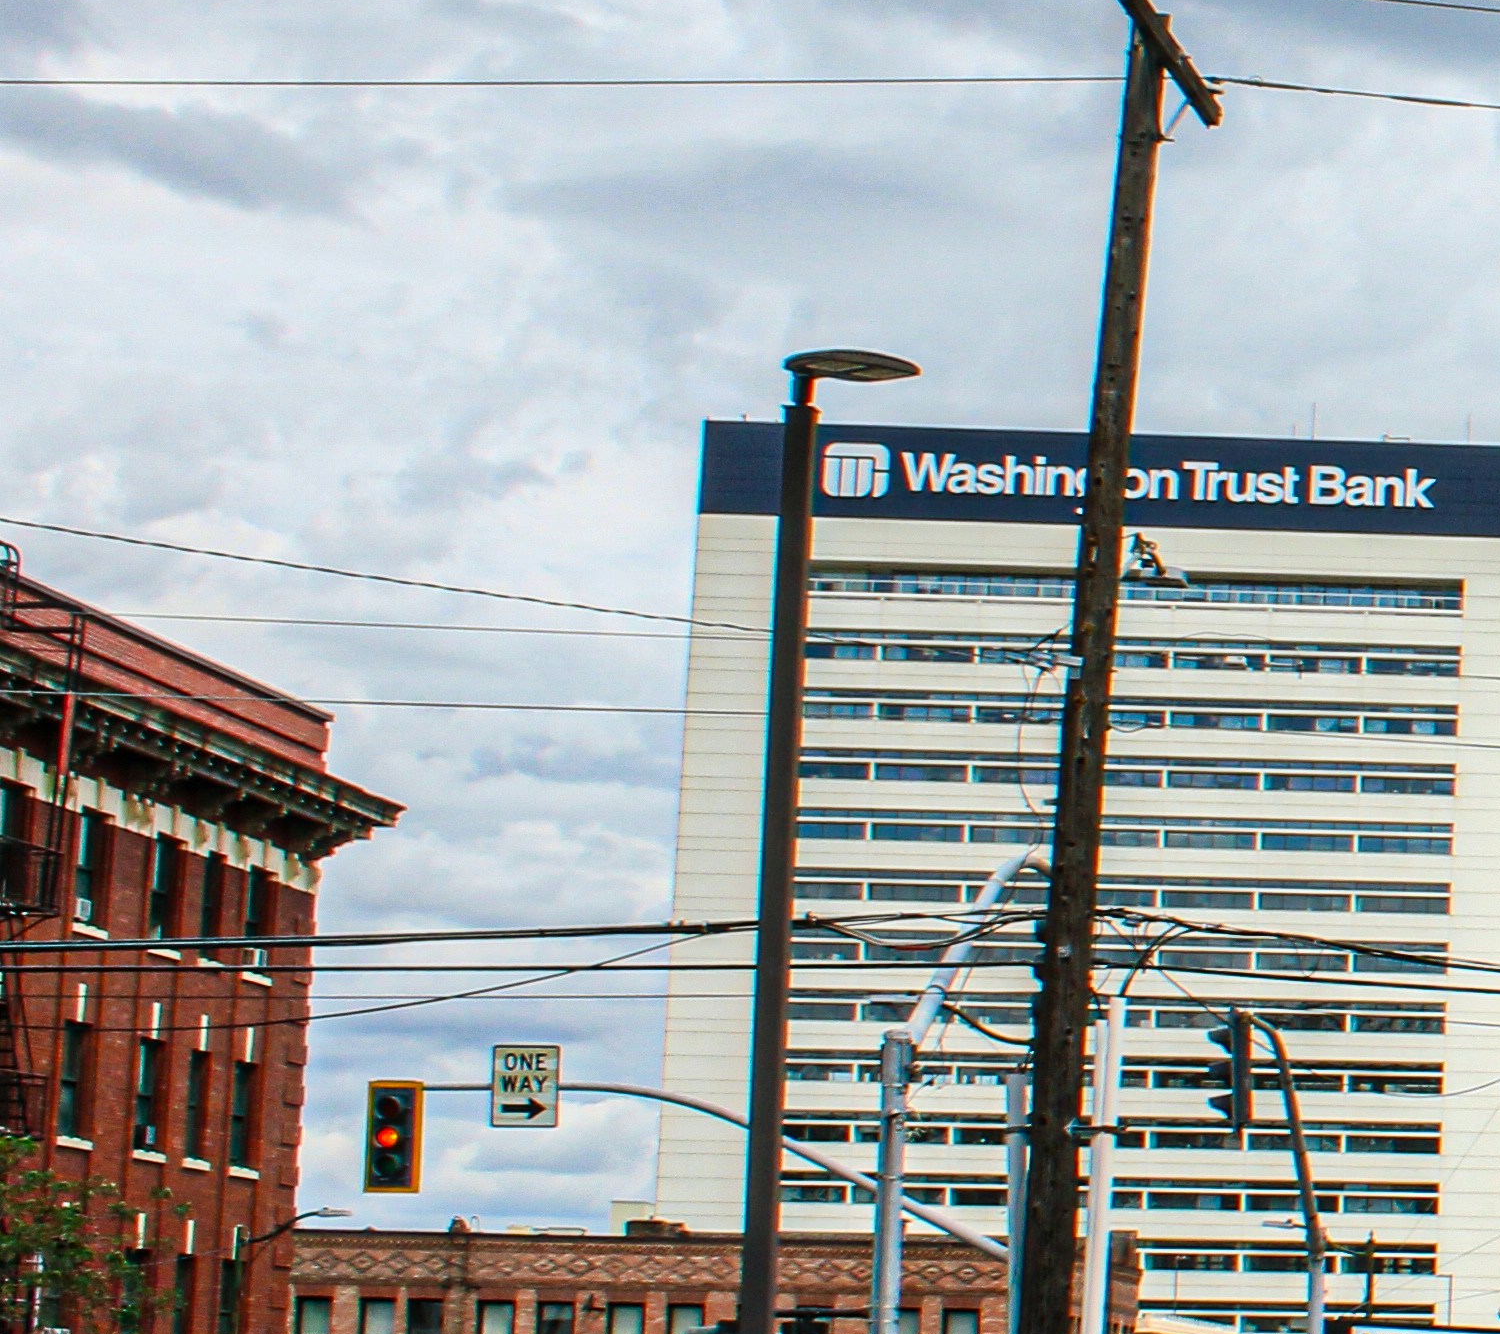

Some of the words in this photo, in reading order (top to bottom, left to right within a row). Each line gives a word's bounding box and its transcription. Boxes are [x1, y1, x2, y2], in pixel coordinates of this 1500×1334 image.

[900, 449, 1181, 515] Washinon
[1183, 460, 1300, 504] Trust
[1308, 465, 1437, 510] Bank
[504, 1052, 548, 1071] ONE
[501, 1075, 549, 1093] WAY
